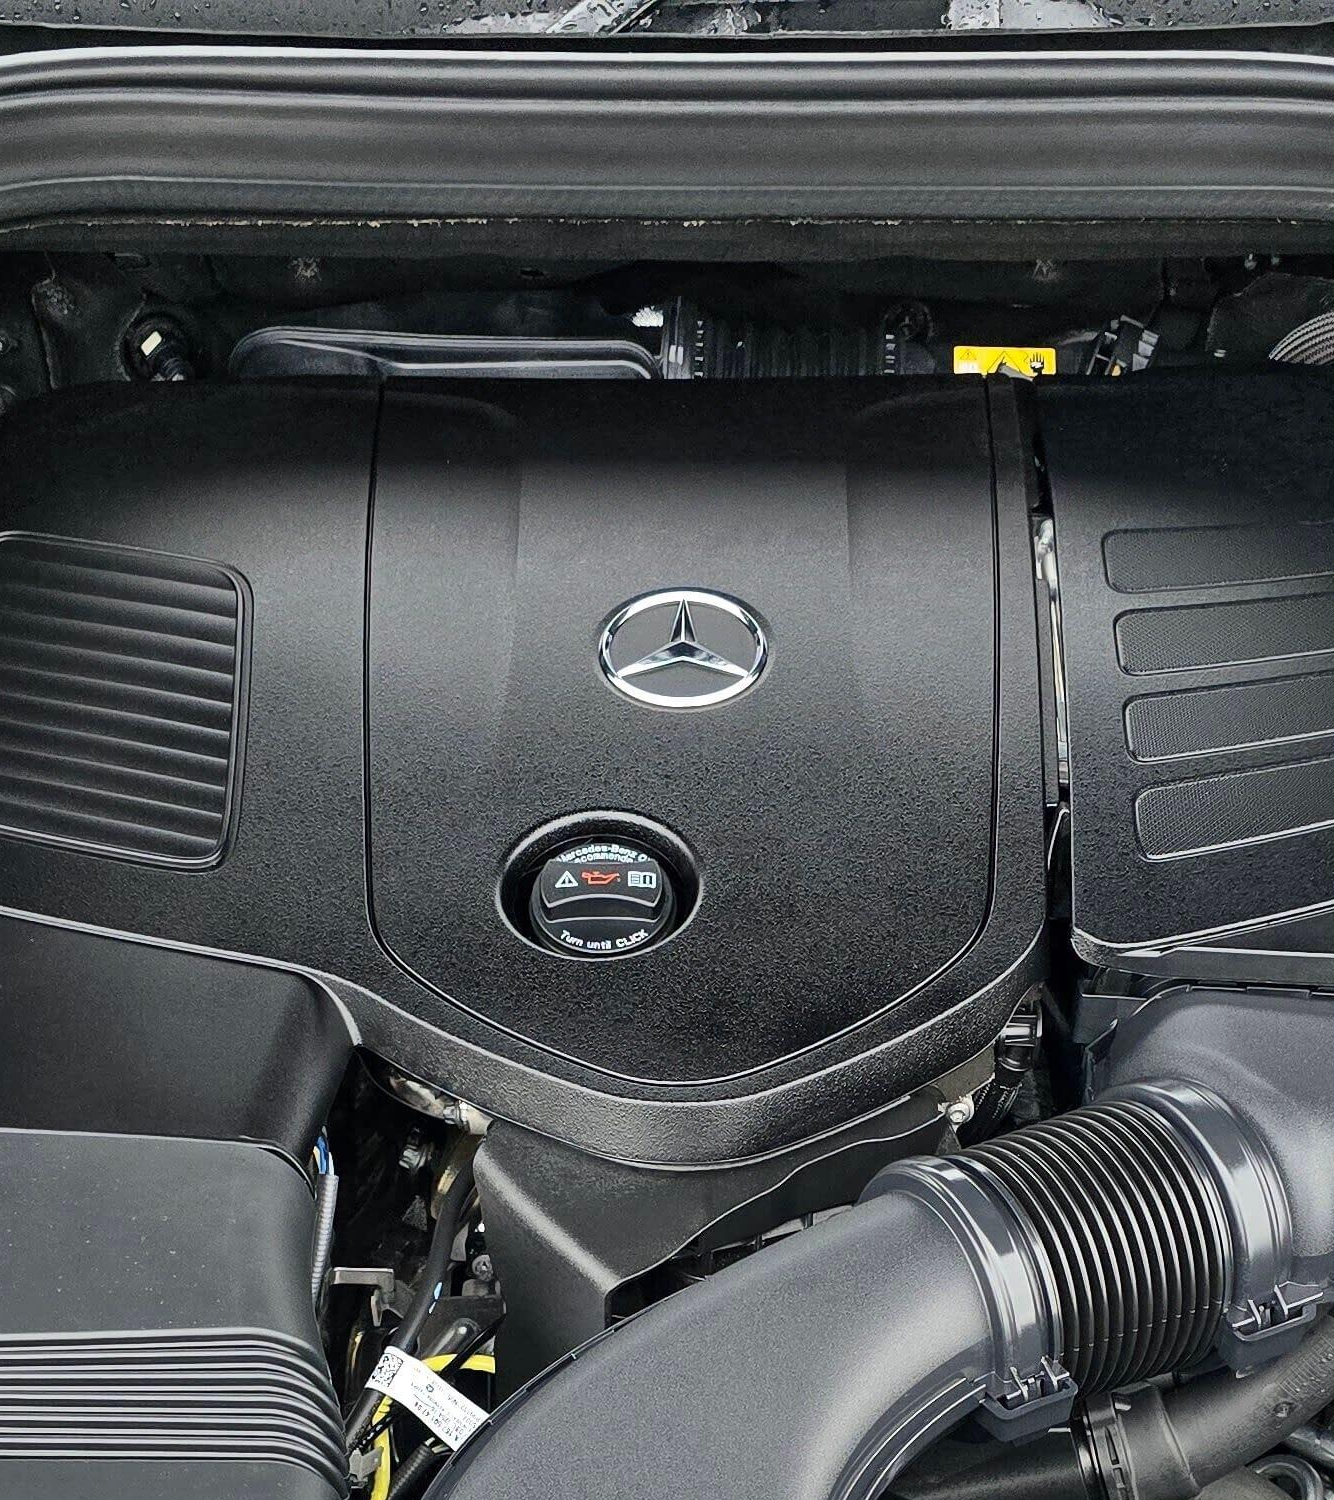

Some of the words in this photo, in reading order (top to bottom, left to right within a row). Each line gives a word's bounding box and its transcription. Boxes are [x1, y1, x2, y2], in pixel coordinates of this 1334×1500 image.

[560, 930, 584, 947] Turn
[587, 940, 612, 949] until
[615, 929, 649, 948] CLICK
